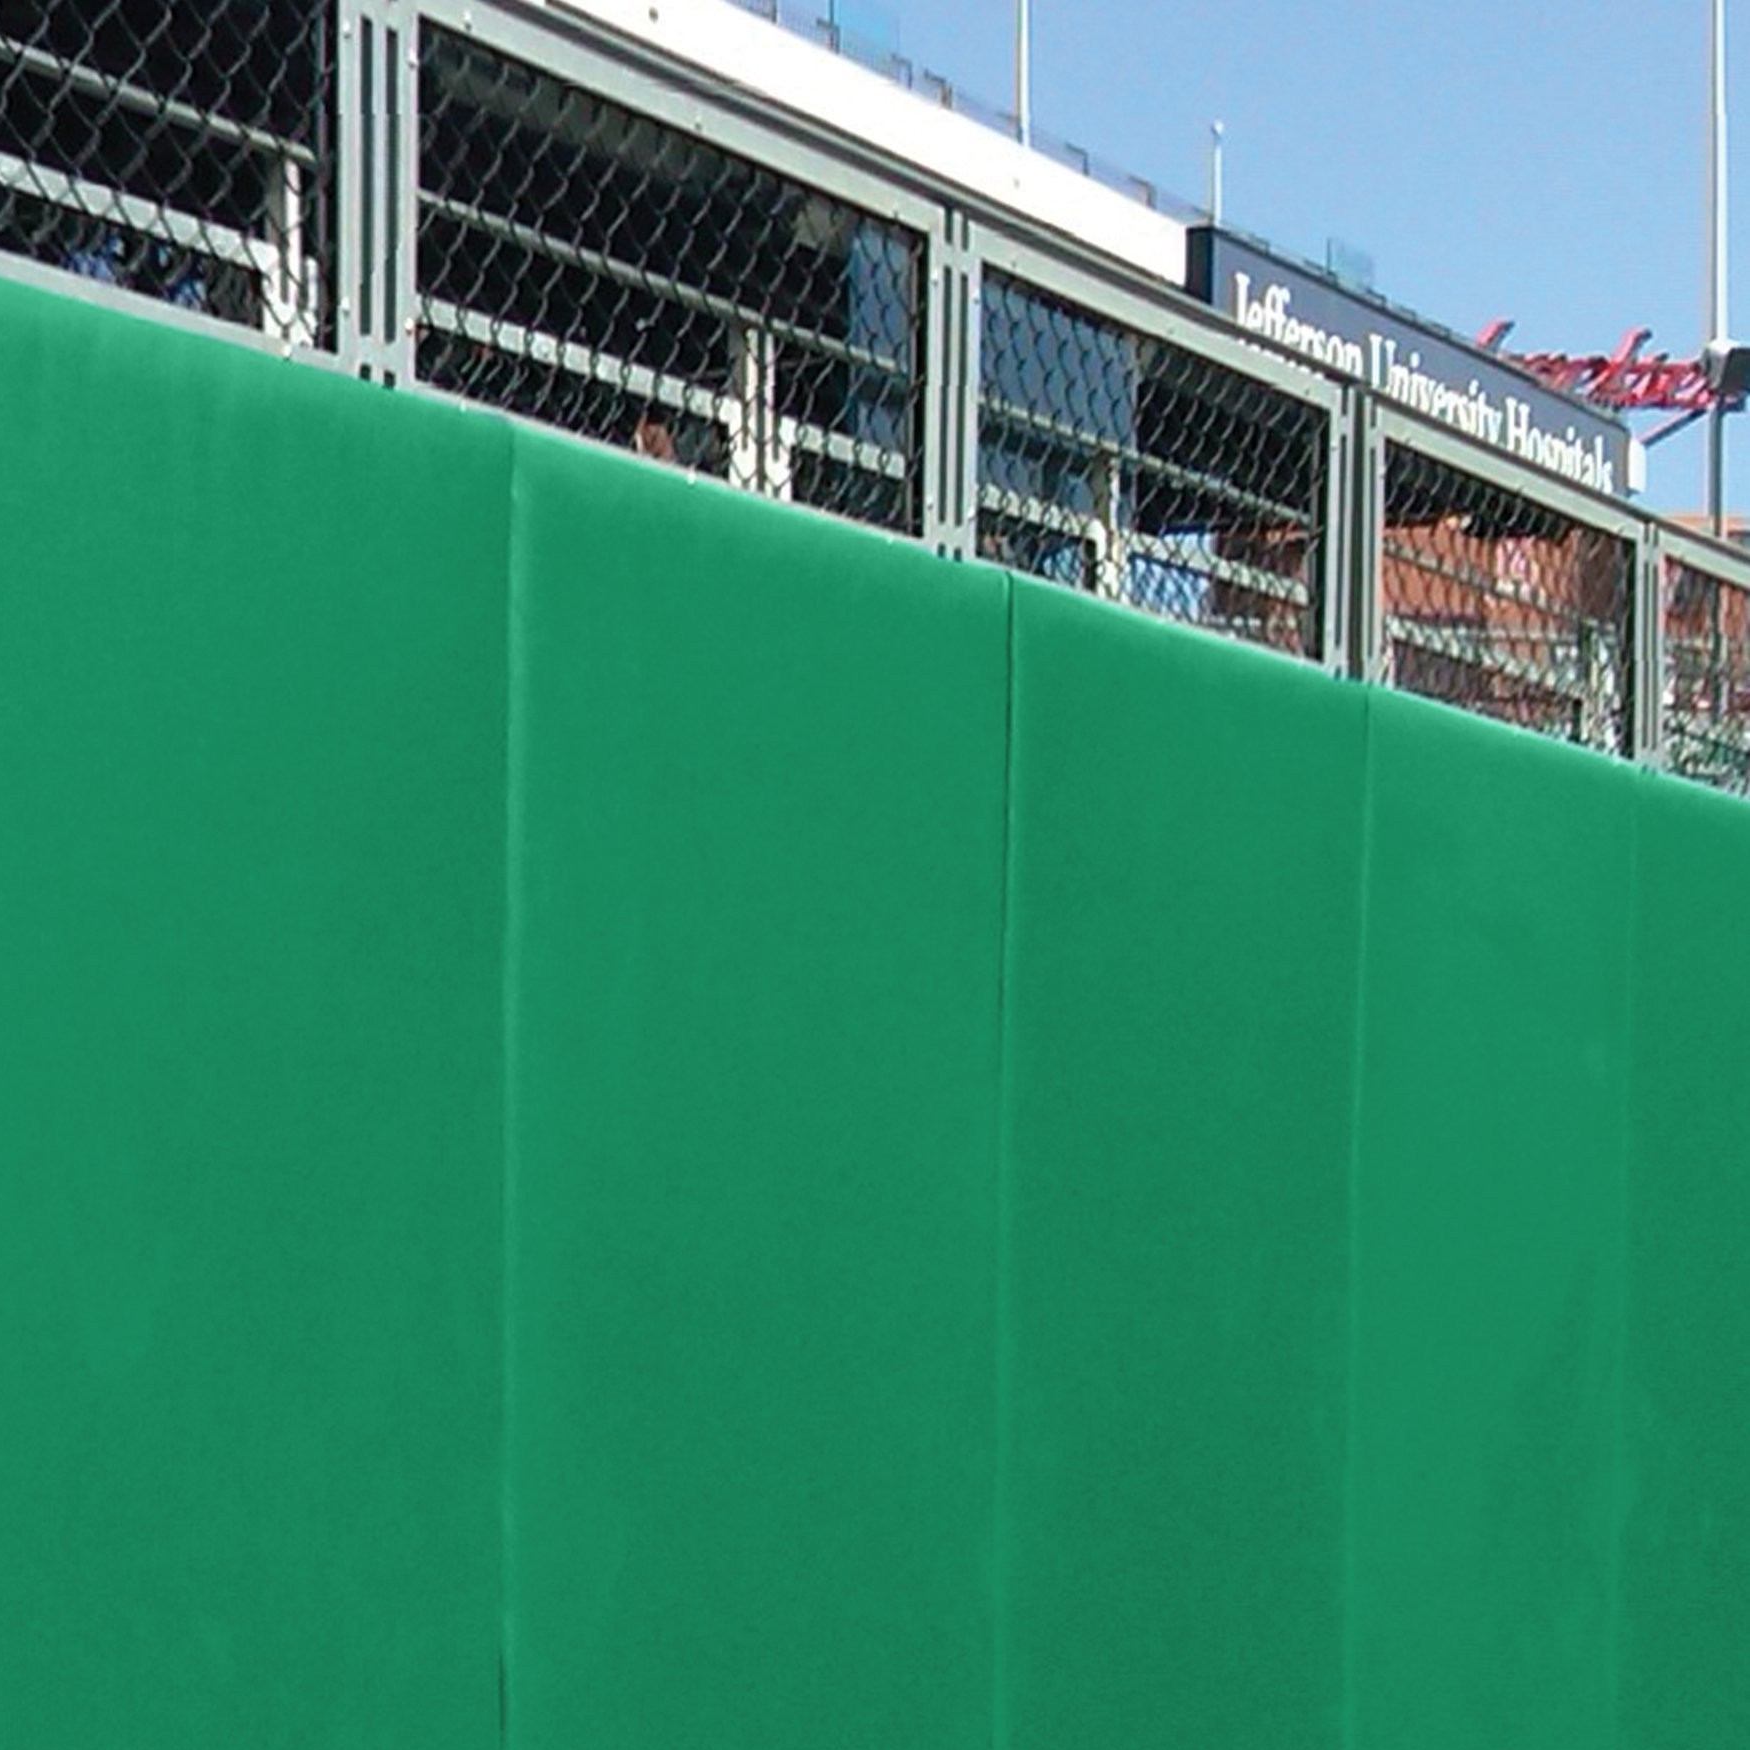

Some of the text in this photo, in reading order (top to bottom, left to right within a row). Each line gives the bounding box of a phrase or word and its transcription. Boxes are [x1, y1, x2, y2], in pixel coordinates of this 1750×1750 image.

[1235, 271, 1364, 379] Jefferson
[1369, 333, 1503, 445] University
[1505, 397, 1613, 495] Hospitals
